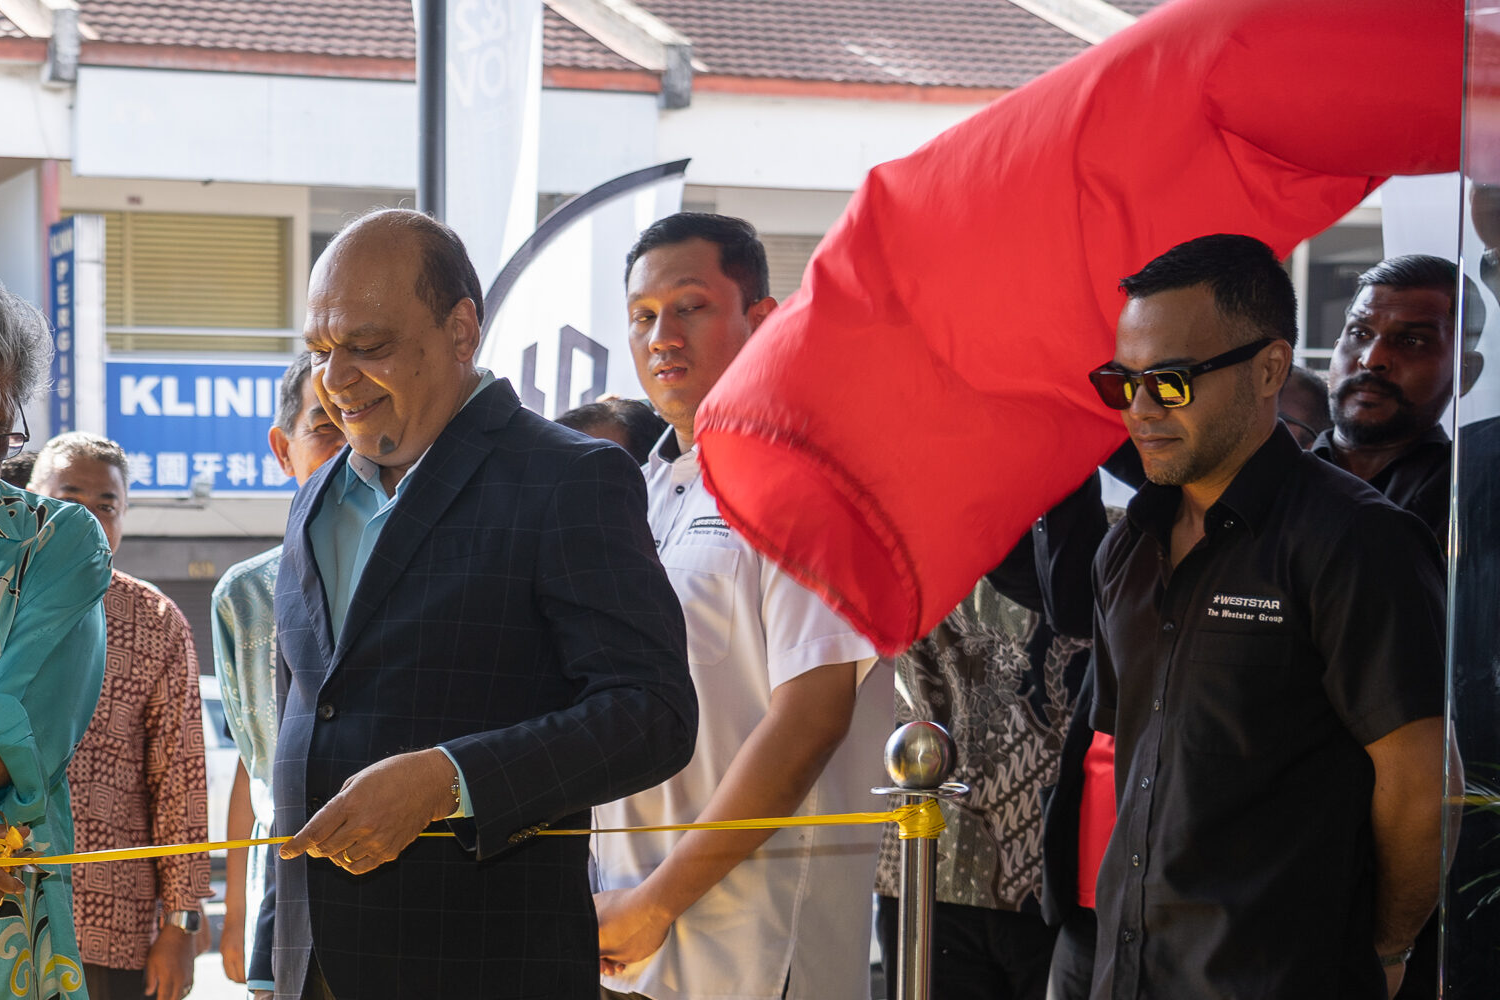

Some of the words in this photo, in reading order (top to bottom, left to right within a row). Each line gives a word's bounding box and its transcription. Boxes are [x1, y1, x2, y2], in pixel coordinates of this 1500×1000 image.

[1220, 595, 1280, 609] WESTSTAR
[1207, 608, 1219, 617] The
[1221, 609, 1255, 620] Weststar
[1258, 613, 1283, 623] Group
